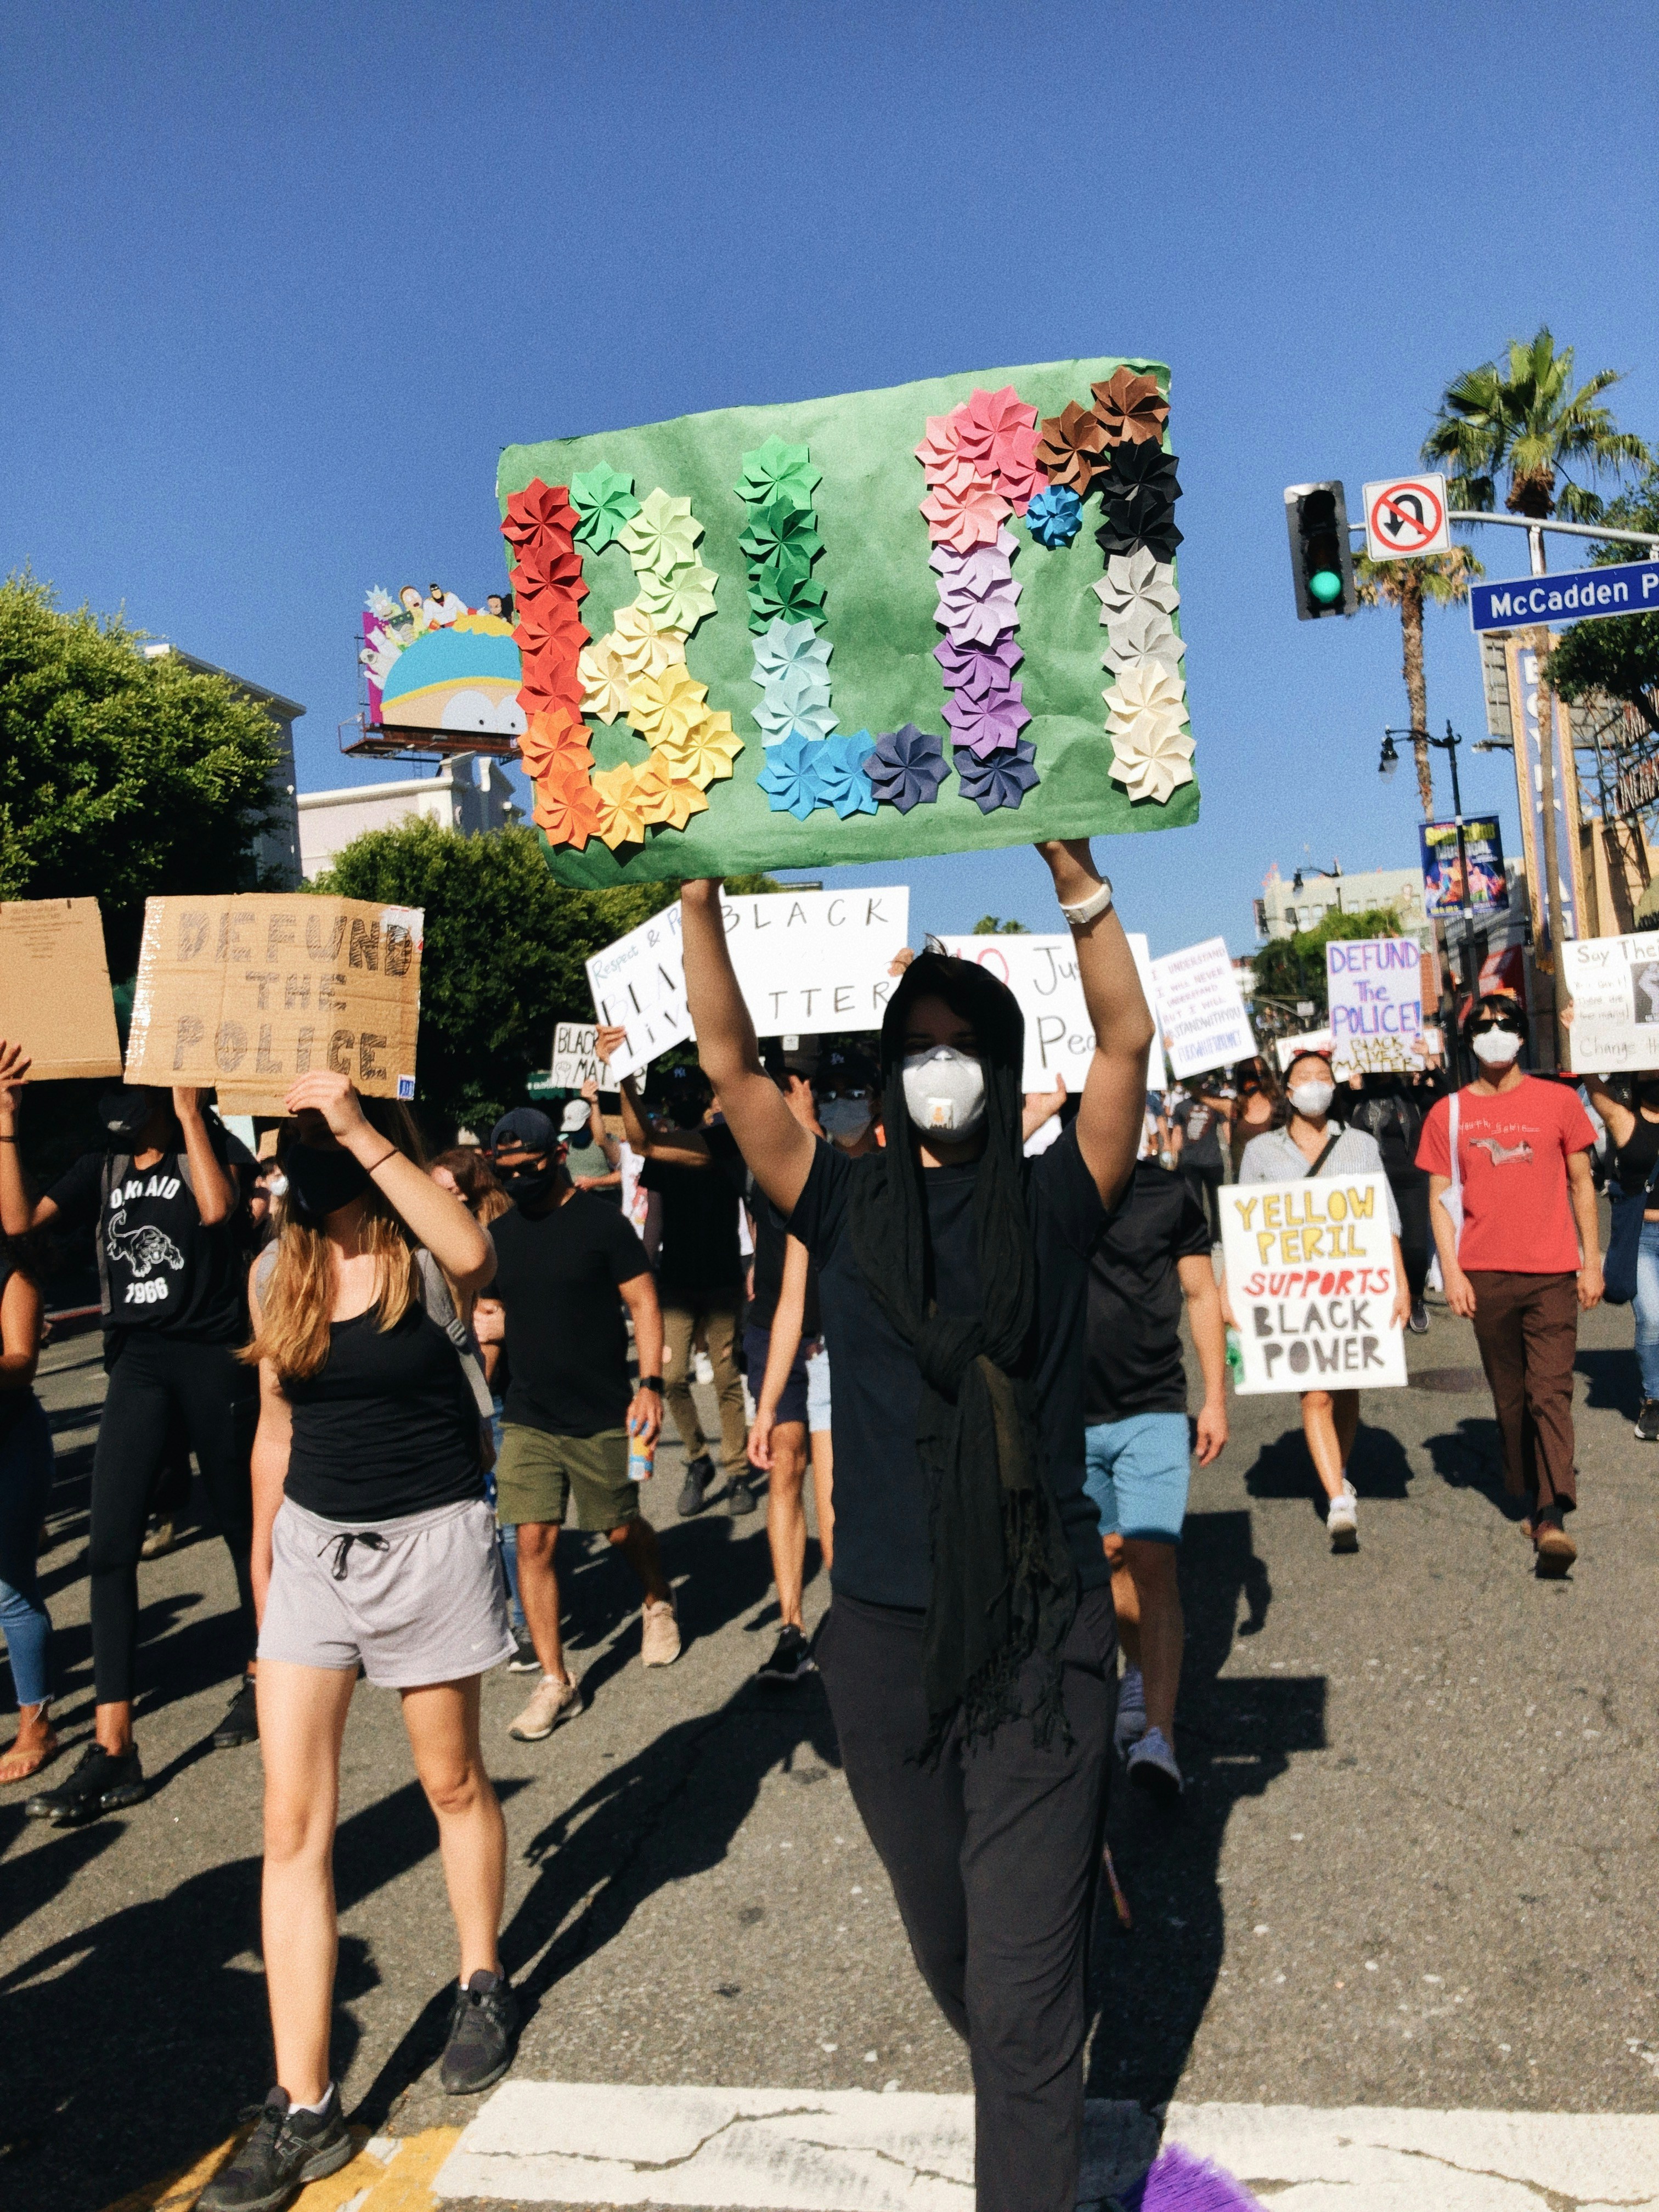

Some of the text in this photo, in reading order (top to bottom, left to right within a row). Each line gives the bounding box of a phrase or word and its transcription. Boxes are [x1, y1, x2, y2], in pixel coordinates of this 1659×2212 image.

[500, 365, 1195, 850] BLM
[1491, 581, 1629, 619] McCadden
[721, 898, 889, 934] BLACK
[178, 912, 413, 978] DEFUND
[591, 944, 639, 989] Respect
[647, 929, 661, 948] &
[1329, 941, 1420, 975] DEFUND
[1577, 944, 1610, 967] Say
[245, 970, 347, 1011] THE
[600, 963, 684, 1026] BLA
[768, 981, 890, 1020] TTER
[1353, 979, 1390, 1002] The
[1331, 1001, 1421, 1038] POLICE!
[173, 1015, 387, 1081] POLICE
[1350, 1036, 1404, 1051] BLACK
[1579, 1036, 1636, 1064] Change
[1334, 1057, 1423, 1073] MATTER
[1234, 1186, 1376, 1231] YELLOW
[1256, 1226, 1367, 1265] PERIL
[124, 1277, 168, 1304] 1966
[1243, 1266, 1390, 1299] SUPPORTS
[1253, 1299, 1373, 1338] BLACK
[1262, 1335, 1385, 1379] POWER
